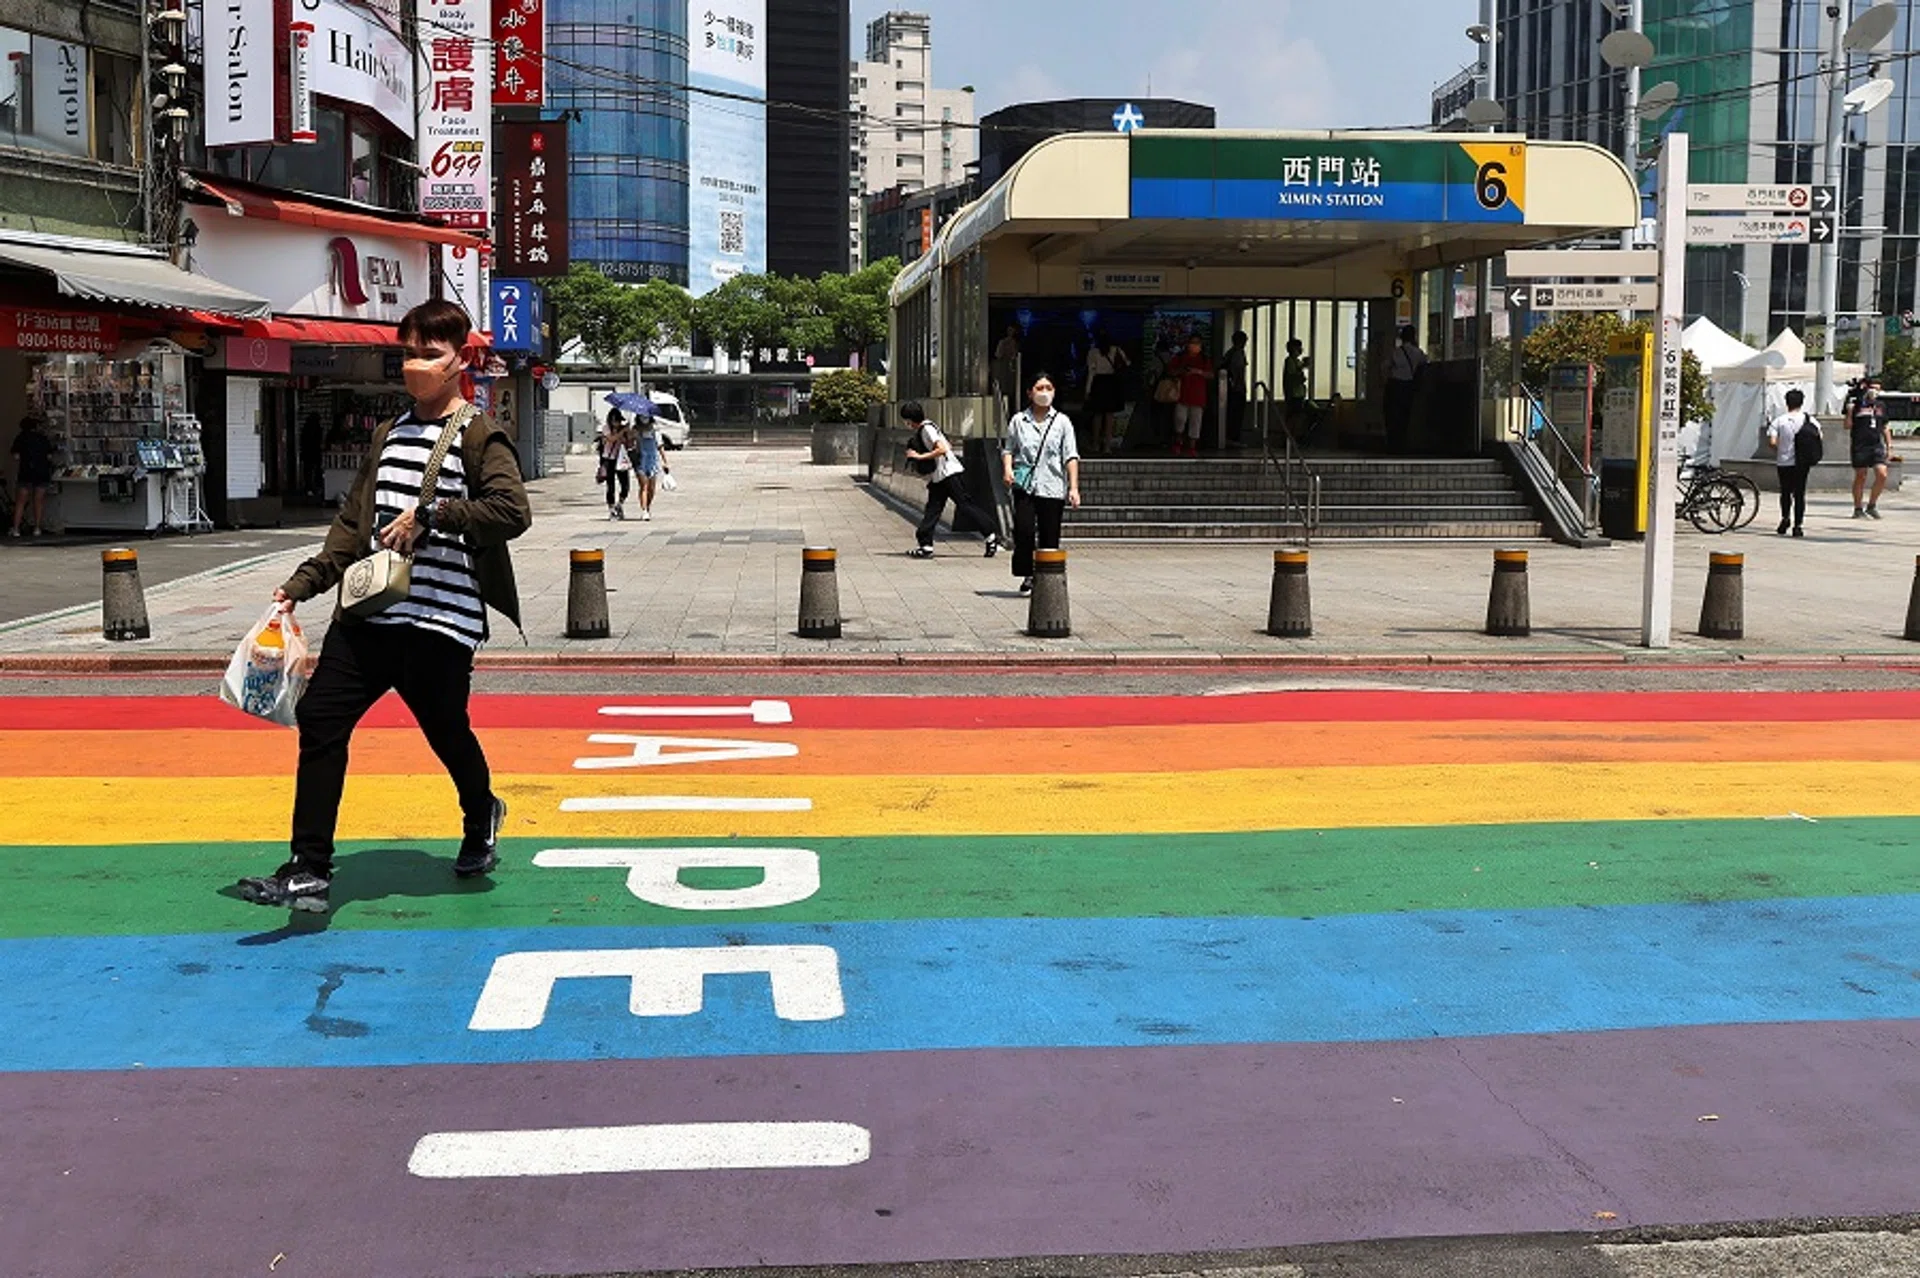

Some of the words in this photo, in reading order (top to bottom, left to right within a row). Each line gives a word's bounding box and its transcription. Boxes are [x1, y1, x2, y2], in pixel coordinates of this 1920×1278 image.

[439, 10, 467, 19] Body
[228, 26, 249, 122] Salon
[431, 37, 475, 111] 護膚
[427, 126, 479, 135] Treatment
[441, 115, 466, 125] Face
[1281, 155, 1381, 188] 西門站
[1476, 161, 1507, 209] 6
[1278, 192, 1323, 206] XIMEN
[1326, 193, 1384, 206] STATION
[407, 699, 872, 1179] TAIPEI
